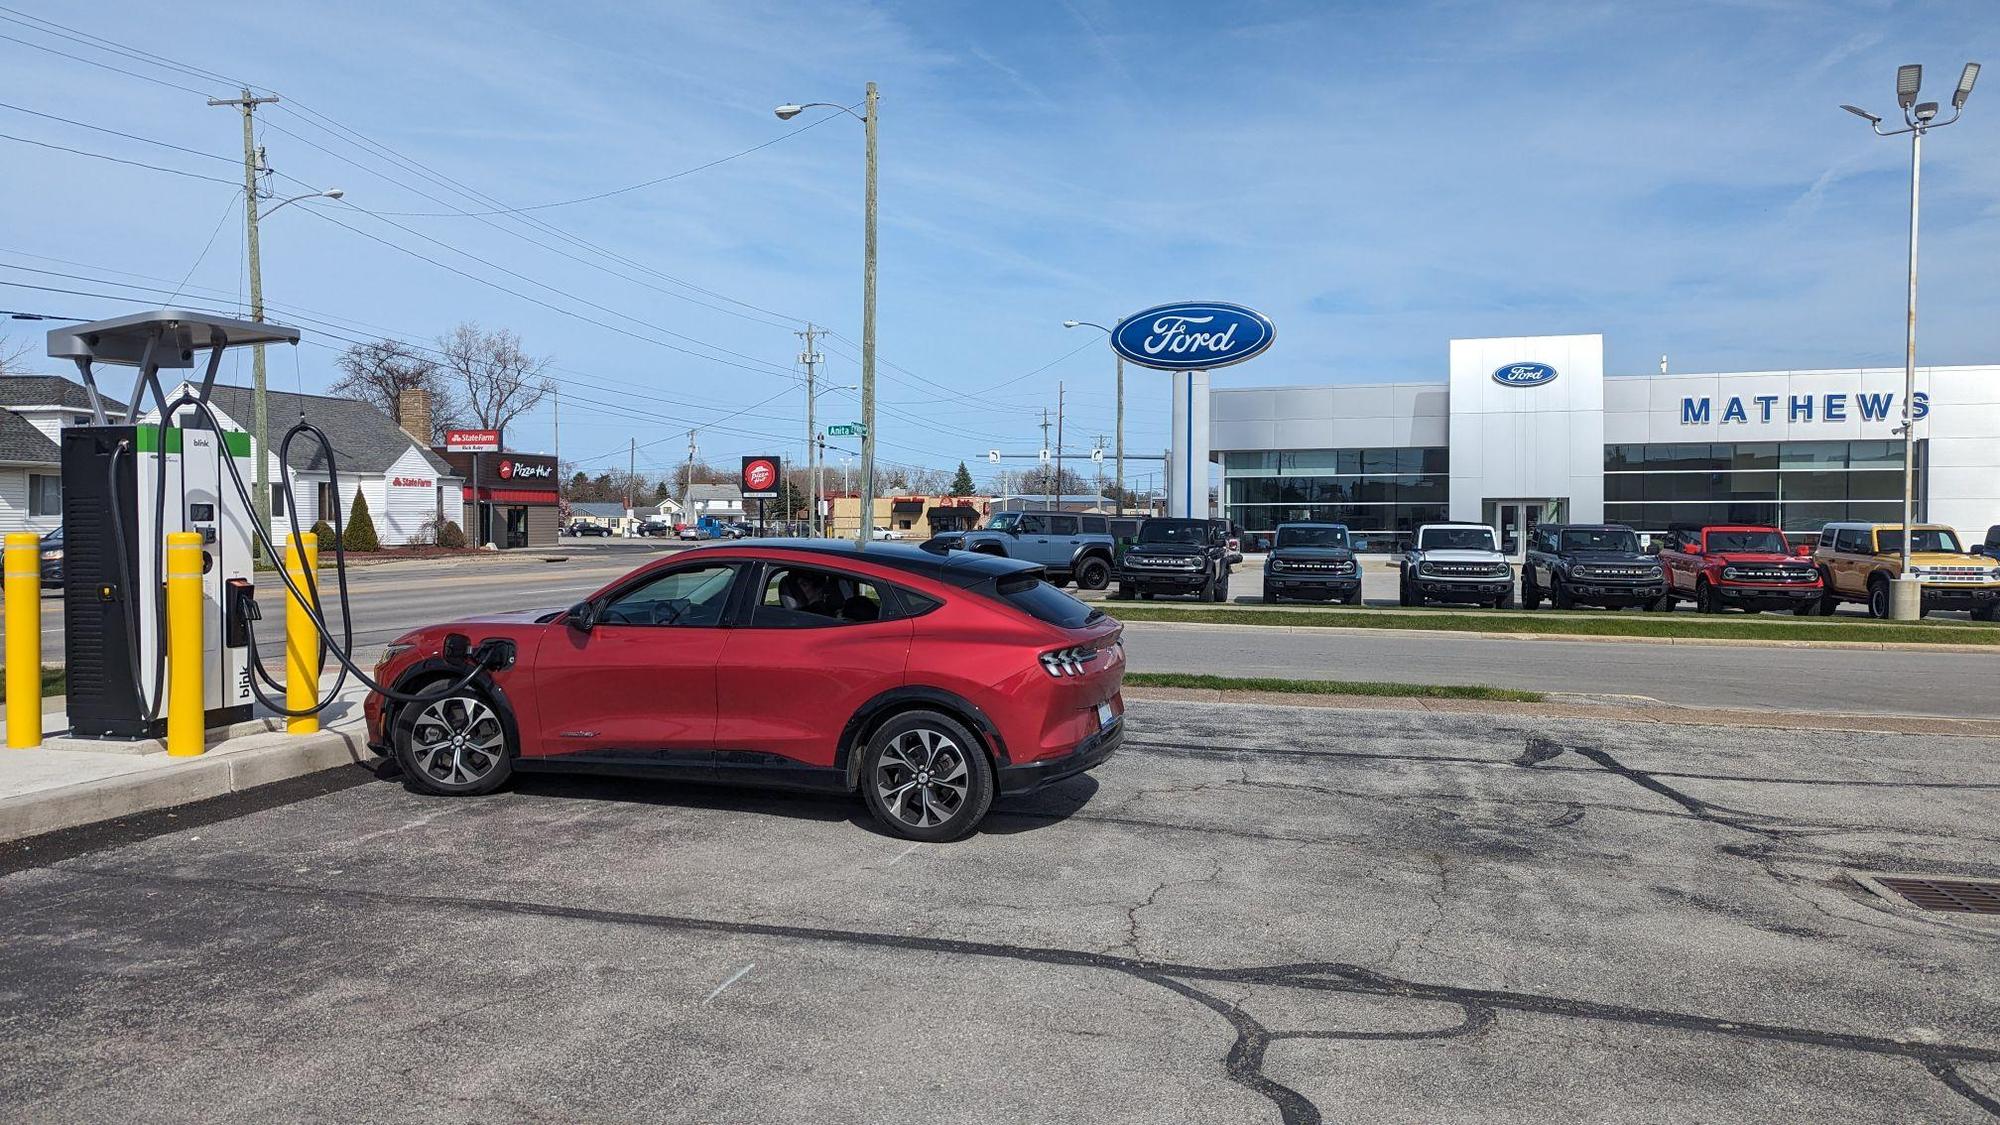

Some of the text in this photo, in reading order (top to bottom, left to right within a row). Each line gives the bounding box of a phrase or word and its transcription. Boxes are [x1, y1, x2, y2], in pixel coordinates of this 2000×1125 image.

[1144, 315, 1238, 354] Ford
[1508, 366, 1544, 380] Ford
[1682, 392, 1930, 423] MATHEWS
[829, 426, 850, 435] Anita
[193, 439, 210, 448] blink
[512, 462, 553, 478] Pizza Hut
[239, 665, 250, 699] blink
